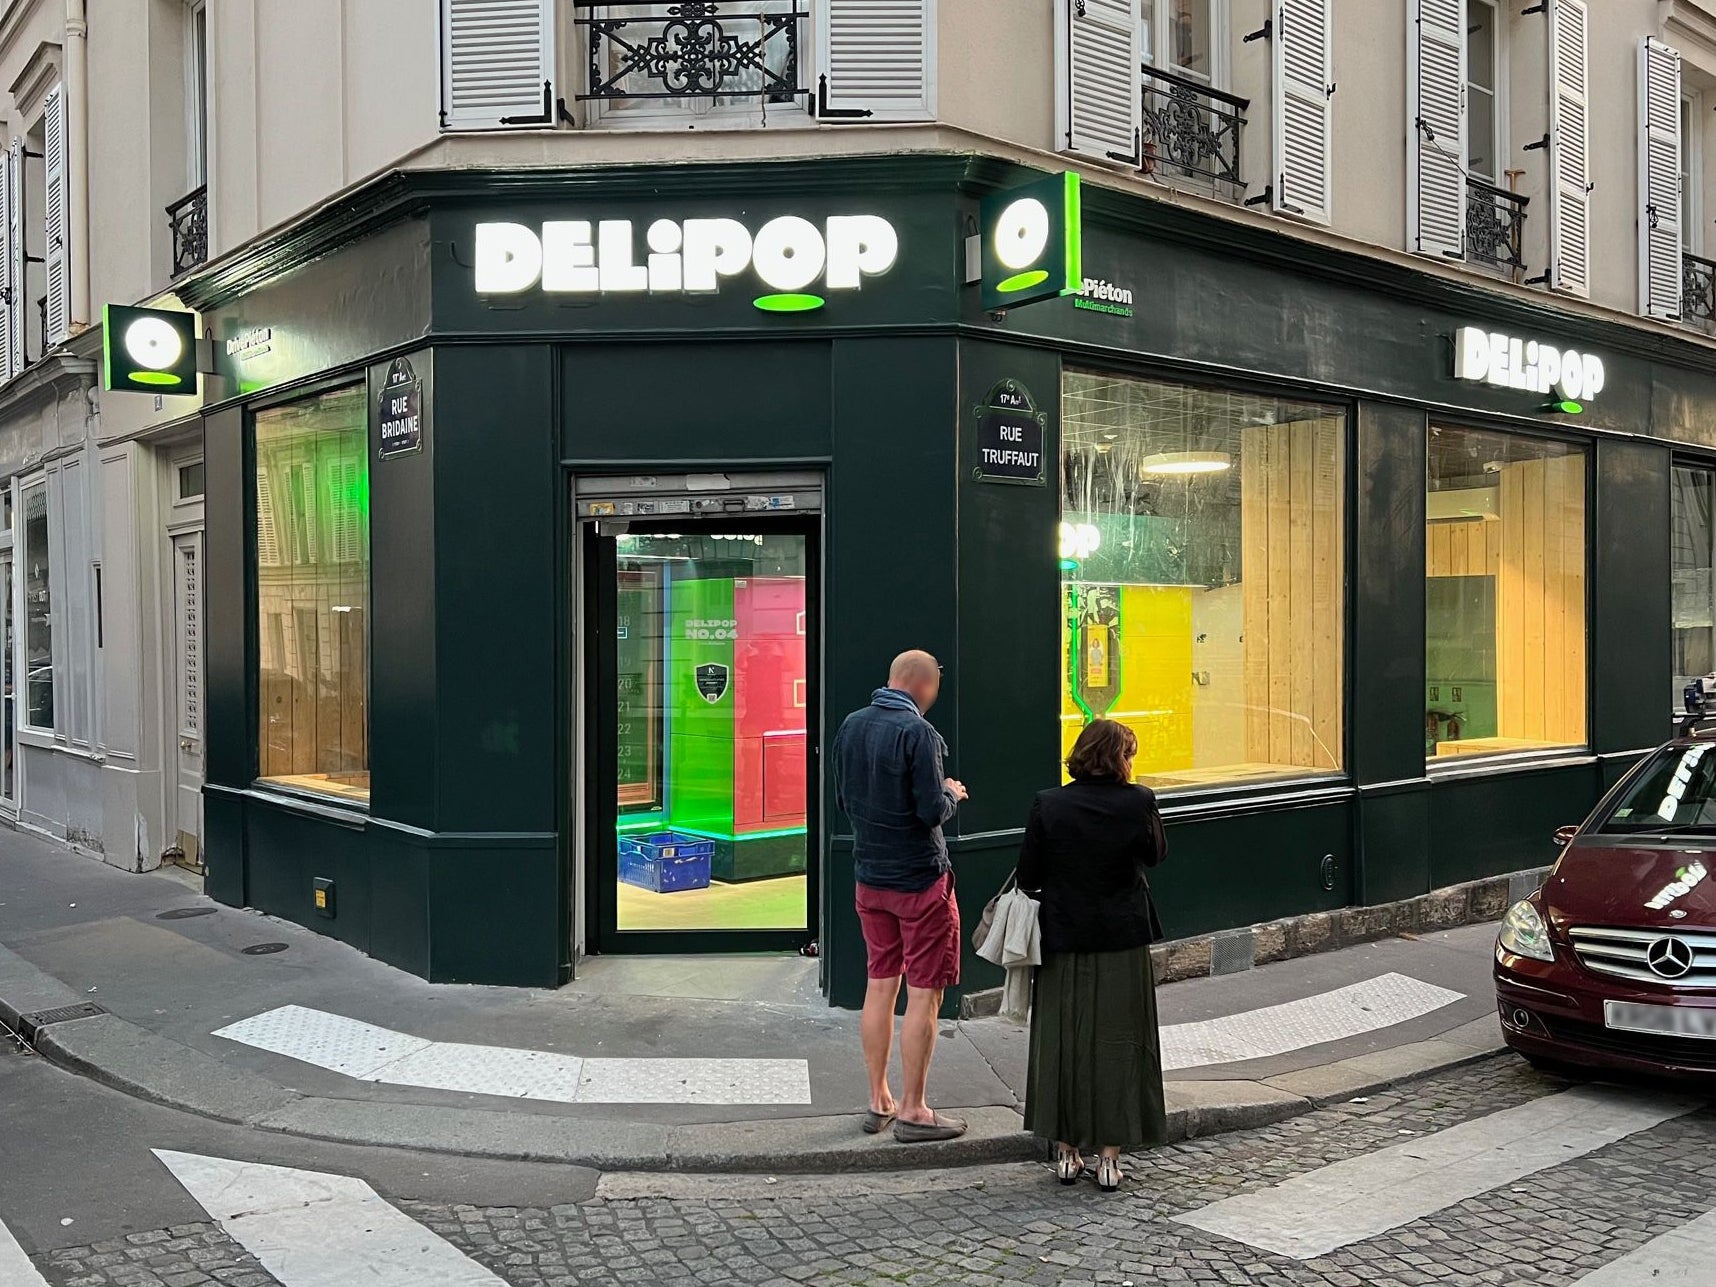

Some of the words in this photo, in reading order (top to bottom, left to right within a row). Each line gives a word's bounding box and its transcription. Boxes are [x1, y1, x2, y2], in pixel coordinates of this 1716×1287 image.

[391, 396, 408, 415] RUE
[381, 415, 418, 439] BRIDAINE
[1000, 425, 1023, 442] RUE
[982, 449, 1039, 467] TRUFFAUT
